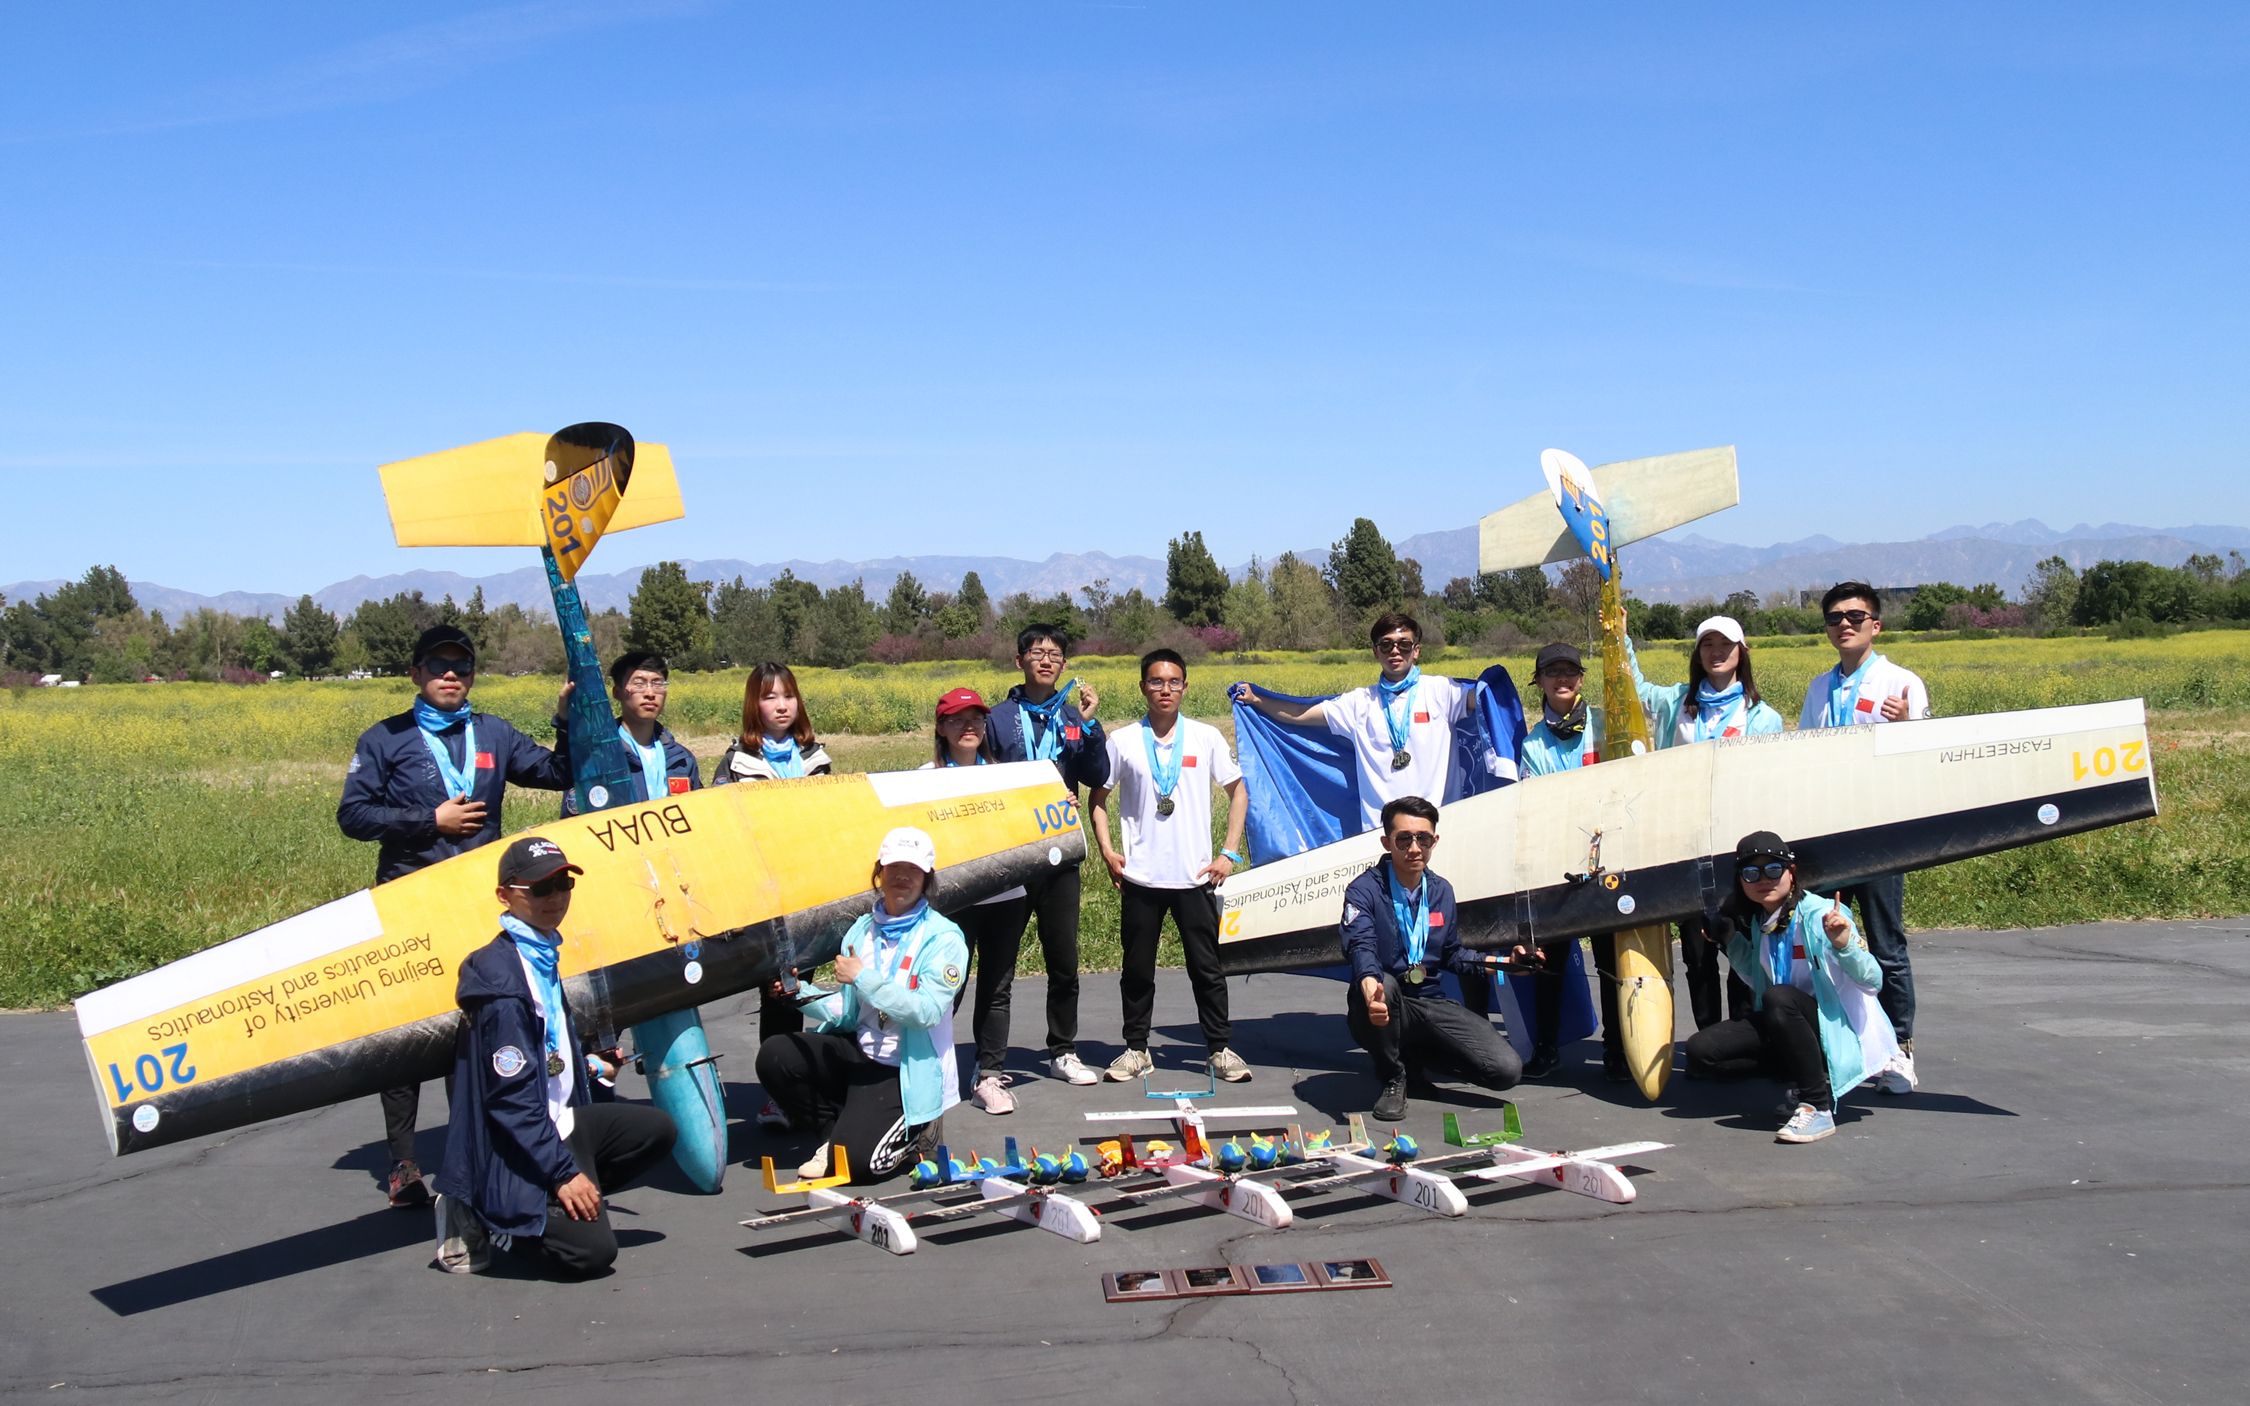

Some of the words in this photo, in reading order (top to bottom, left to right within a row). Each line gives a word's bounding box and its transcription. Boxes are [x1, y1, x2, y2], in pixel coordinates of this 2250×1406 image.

[547, 491, 581, 556] 201
[1588, 502, 1608, 565] 201
[1940, 738, 2051, 763] FA3REETHFM
[2072, 740, 2145, 781] 201
[926, 799, 1006, 822] FA3REETHFM
[1034, 800, 1077, 834] 201
[587, 804, 692, 851] BUAA
[1305, 873, 1330, 888] and
[1224, 881, 1301, 910] Astronautics
[1273, 899, 1288, 912] of
[323, 933, 431, 980] Aeronautics
[282, 971, 319, 998] and
[378, 957, 444, 987] Beijing
[148, 985, 274, 1041] Astronautics
[275, 979, 376, 1024] University
[247, 1014, 266, 1038] of
[109, 1043, 197, 1102] 201
[1414, 1182, 1439, 1210] 201
[1583, 1175, 1604, 1195] 201
[1050, 1206, 1070, 1232] 201
[1242, 1192, 1264, 1219] 201
[871, 1223, 890, 1249] 201
